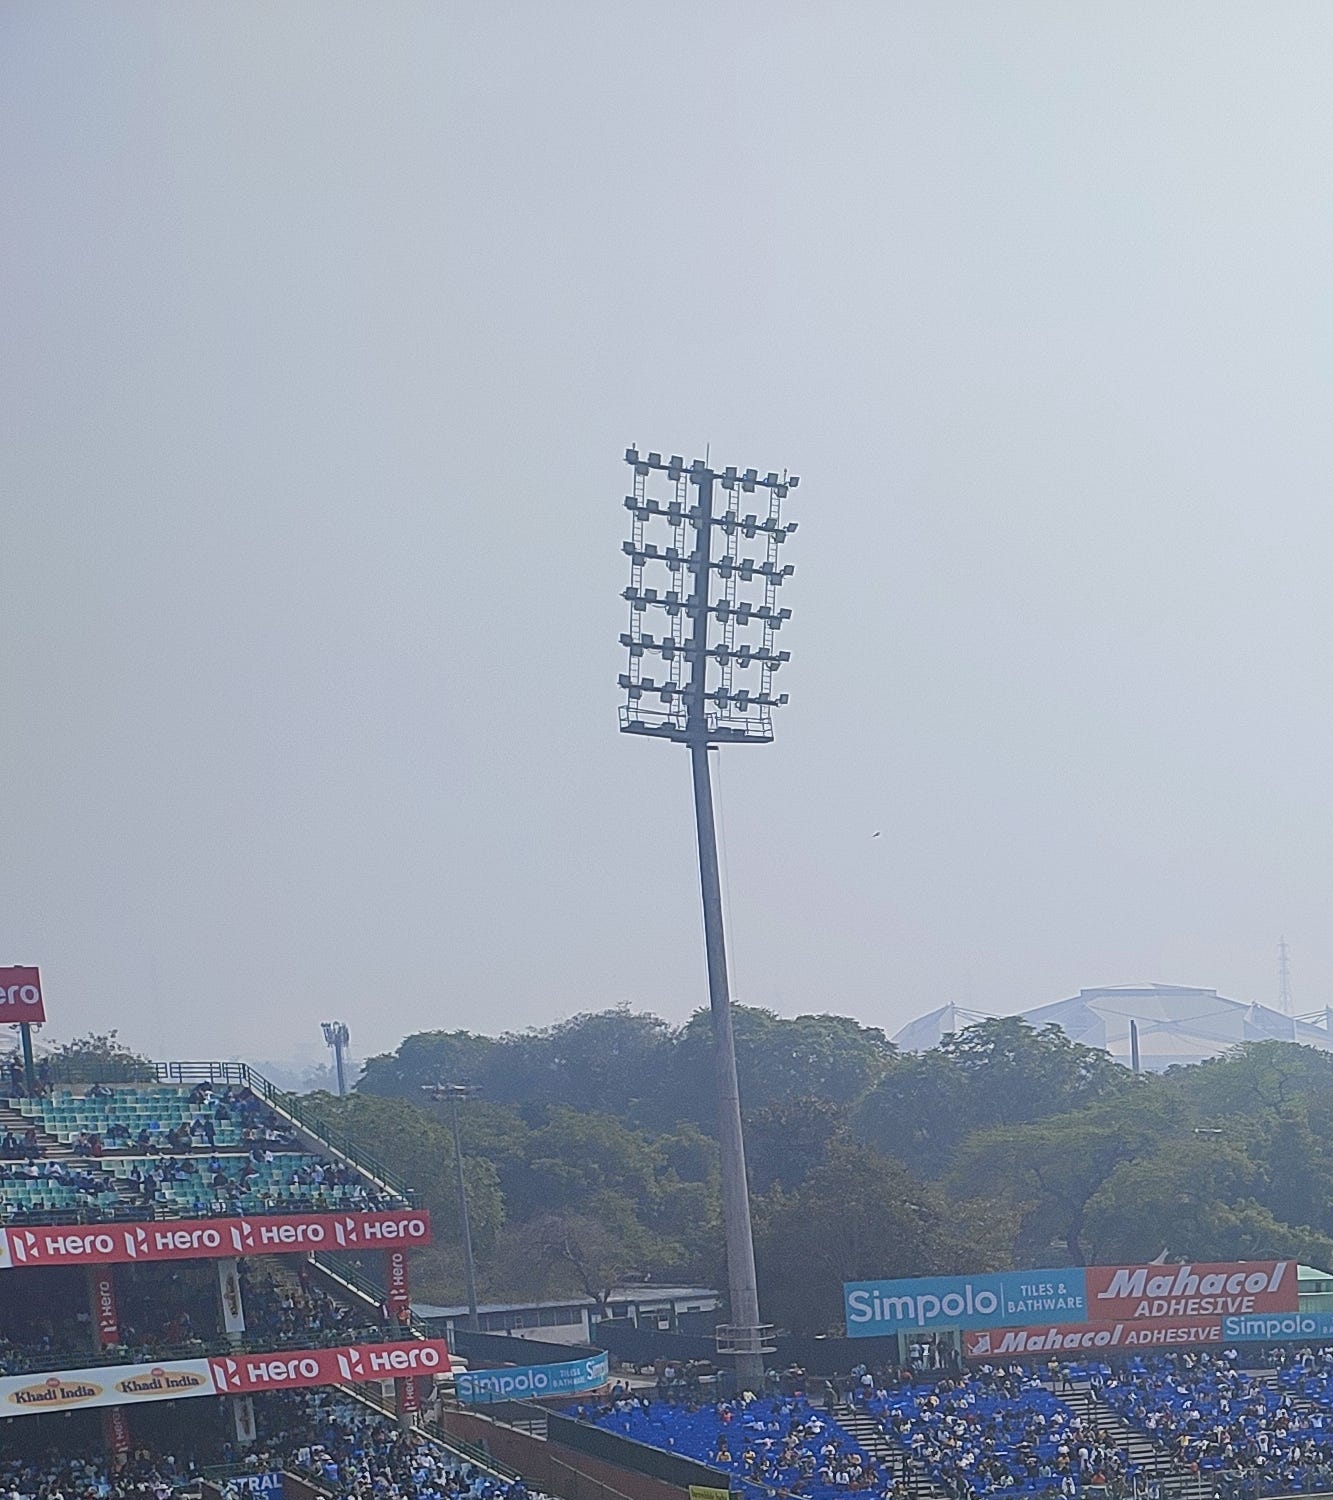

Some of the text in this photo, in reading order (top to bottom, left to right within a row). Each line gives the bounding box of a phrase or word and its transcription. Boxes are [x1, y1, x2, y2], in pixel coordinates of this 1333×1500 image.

[155, 1229, 220, 1249] Hero
[261, 1224, 325, 1243] Hero
[364, 1219, 425, 1239] Hero
[45, 1235, 114, 1255] Hero
[392, 1253, 403, 1287] Hero
[1097, 1262, 1287, 1299] Mahacol
[1021, 1283, 1067, 1296] TILES &
[848, 1284, 998, 1325] Simpolo
[1008, 1296, 1083, 1313] BATHWARE
[1134, 1296, 1255, 1317] ADHESIVE
[1225, 1315, 1316, 1338] Simpolo
[994, 1324, 1221, 1353] Mahacol ADHESIVE
[369, 1347, 439, 1372] Hero
[247, 1358, 319, 1383] Hero
[121, 1375, 200, 1393] Khadi India
[458, 1370, 548, 1396] Simpolo
[15, 1385, 96, 1404] Khadi India
